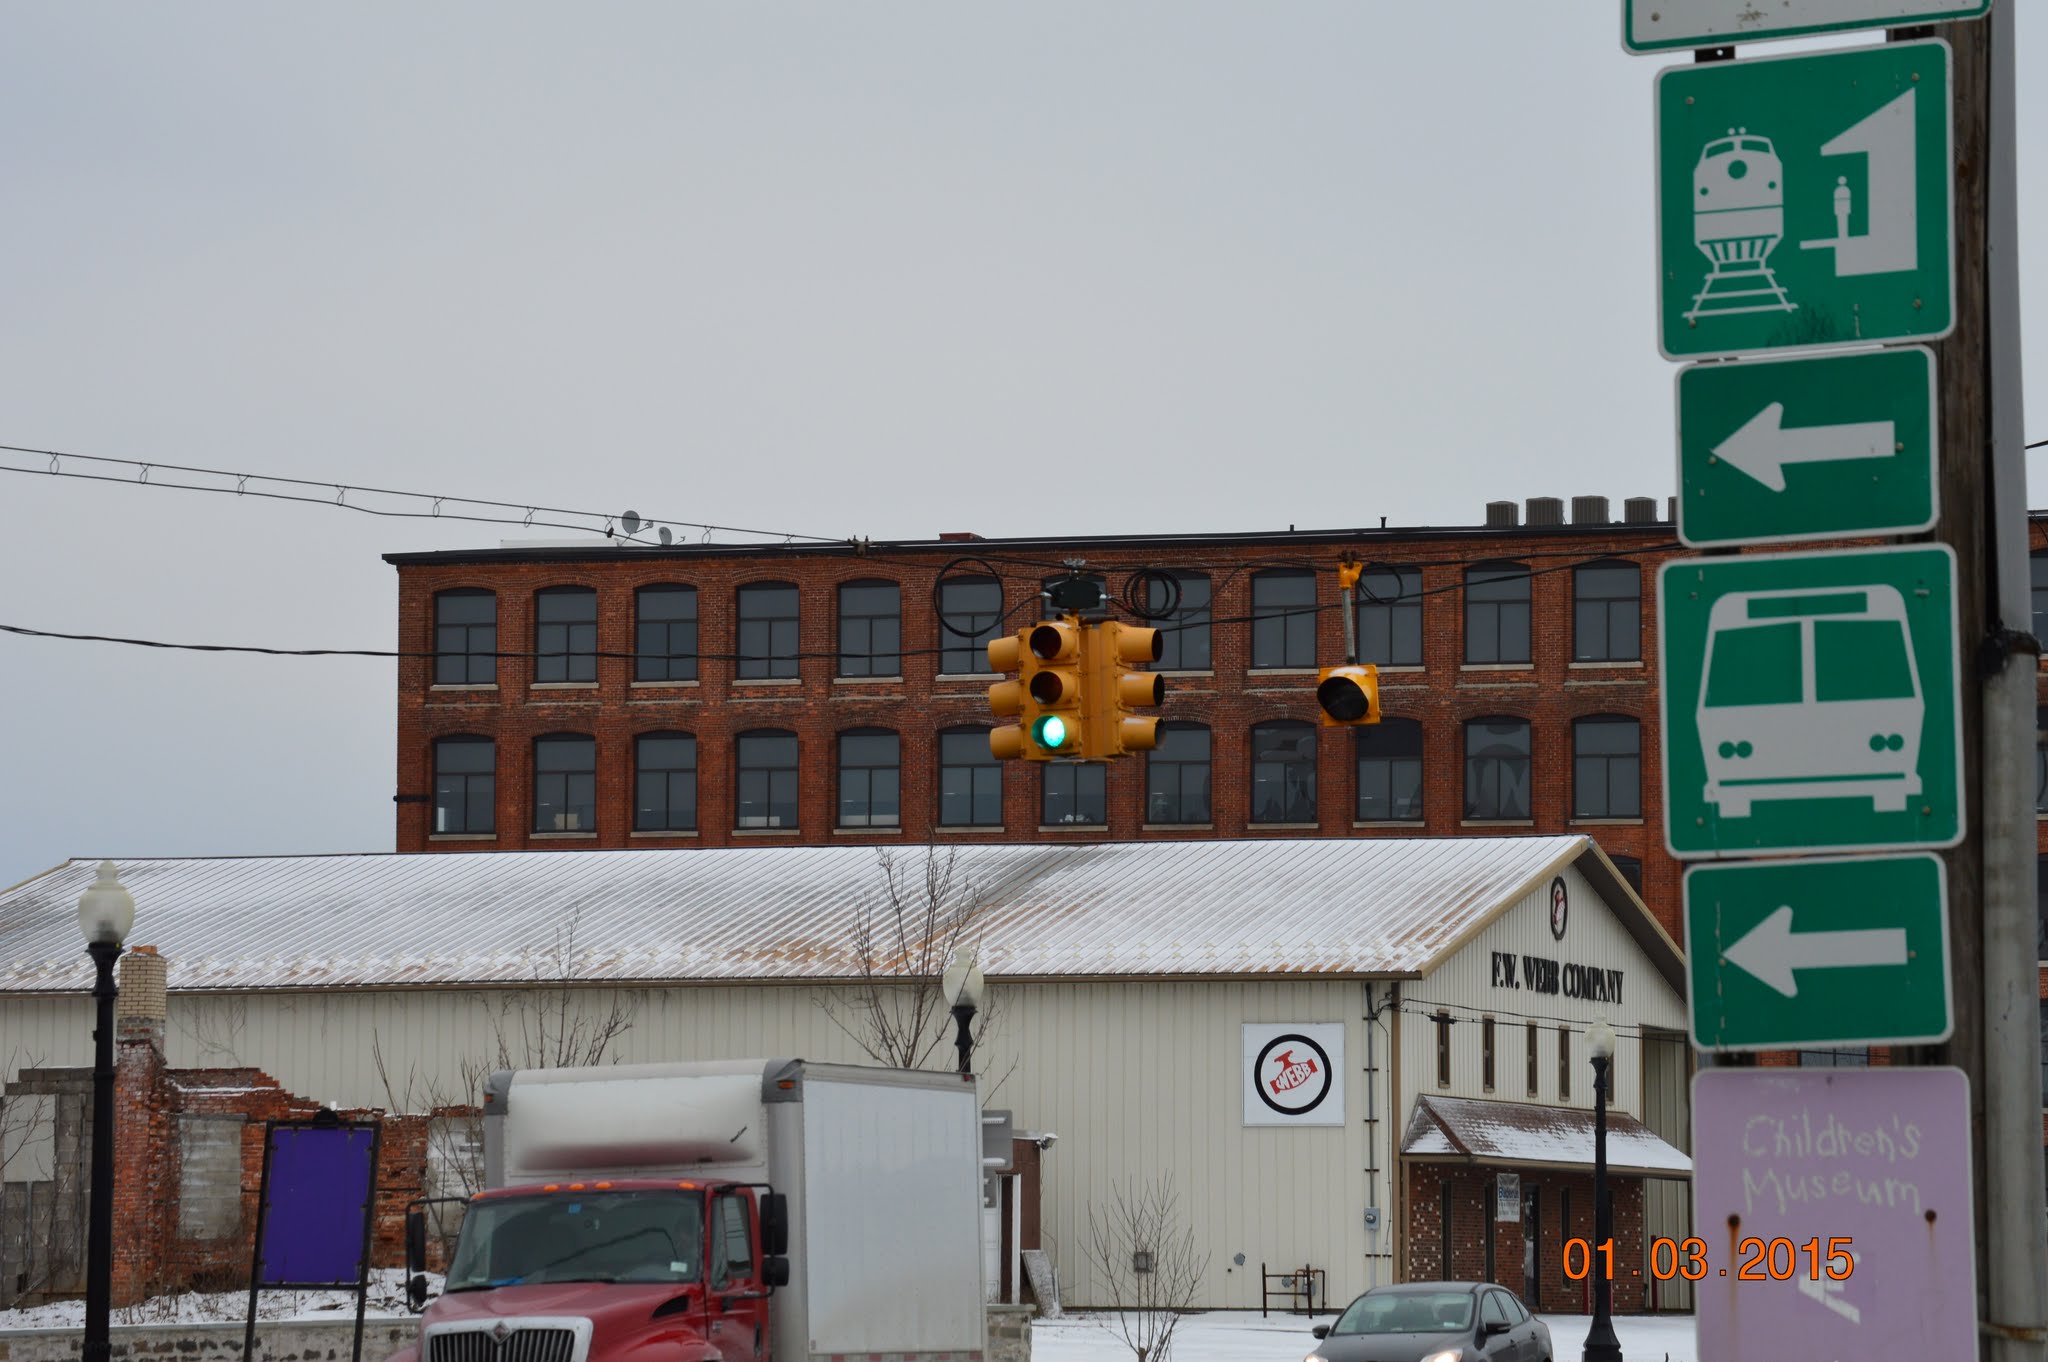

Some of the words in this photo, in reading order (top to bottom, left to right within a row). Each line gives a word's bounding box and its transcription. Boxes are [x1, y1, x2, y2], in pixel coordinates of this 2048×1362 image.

[1492, 951, 1520, 990] F.W.
[1523, 955, 1560, 995] WEBB
[1562, 962, 1624, 1005] COMPANY
[1275, 1063, 1312, 1090] WEBB
[1742, 1105, 1922, 1163] Children's
[1741, 1167, 1921, 1216] Museum
